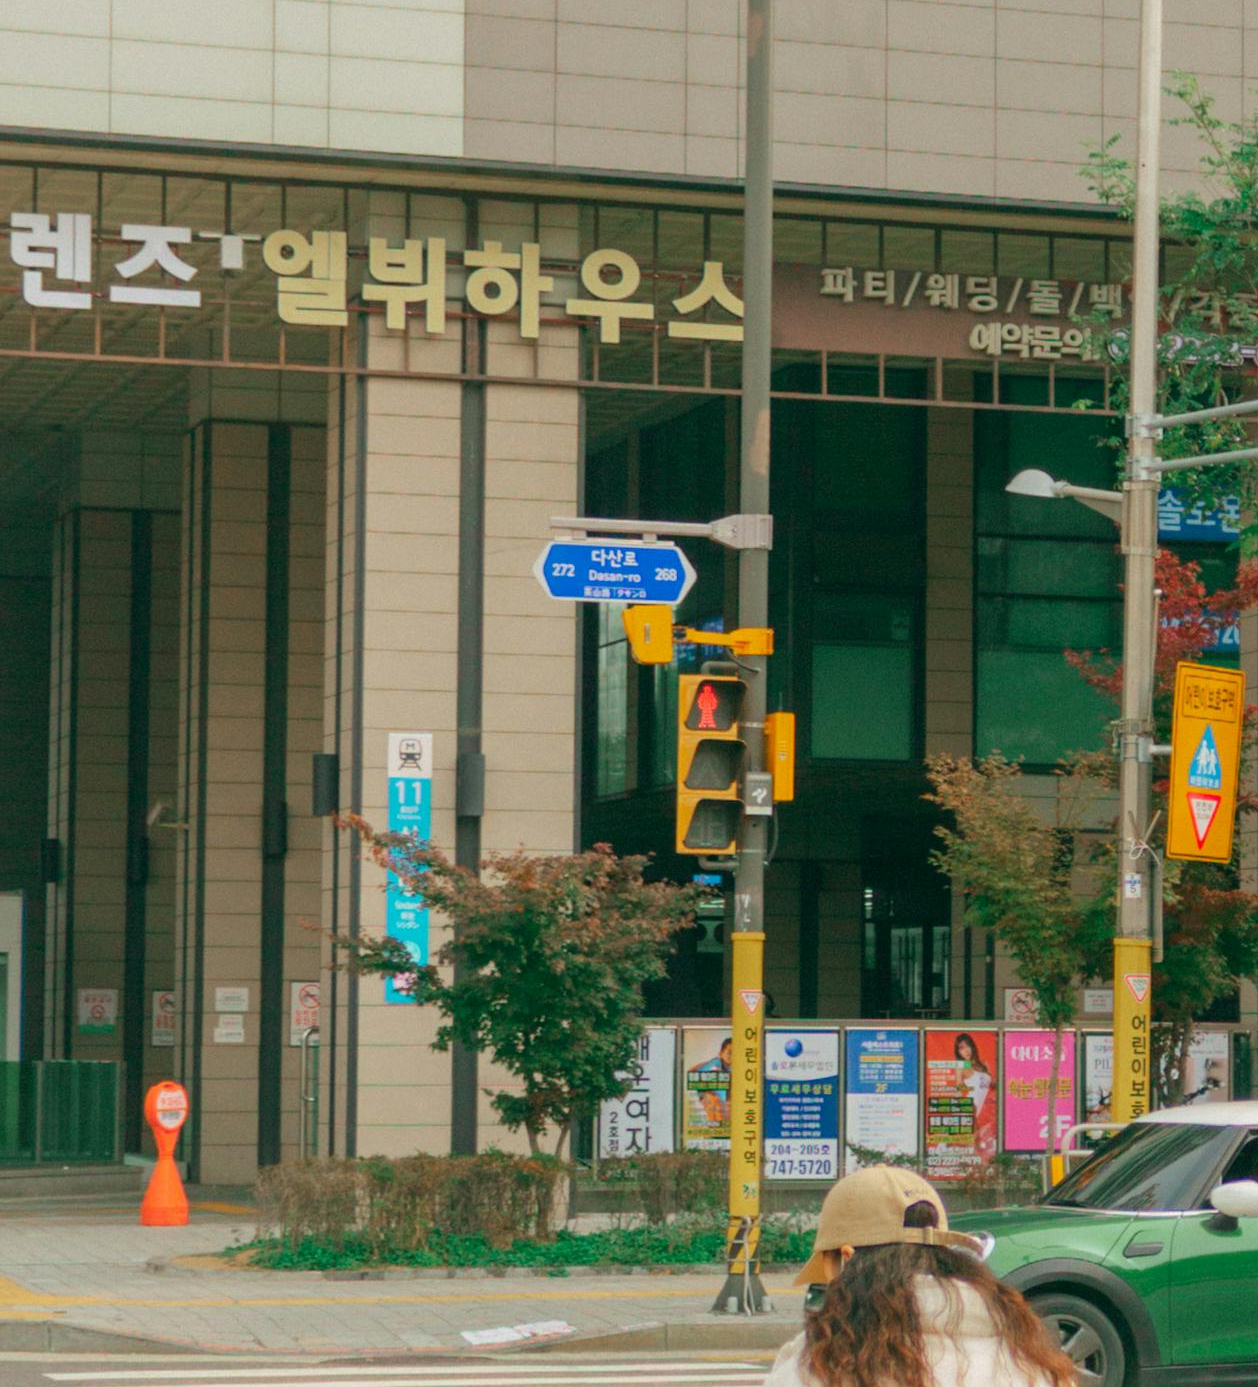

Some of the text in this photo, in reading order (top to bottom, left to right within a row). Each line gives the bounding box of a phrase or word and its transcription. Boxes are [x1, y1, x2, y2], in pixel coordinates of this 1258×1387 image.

[10, 212, 201, 310] 렌즈
[262, 229, 744, 344] 엘뷔하우스
[969, 322, 1099, 362] 예약문의
[591, 549, 639, 568] 다산로
[552, 563, 576, 577] 272
[588, 570, 641, 583] Dasan-ro
[655, 568, 678, 582] 268
[395, 781, 422, 804] 11
[743, 1027, 757, 1165] 어린이보호구역
[1008, 1077, 1072, 1099] 속눈썹문
[1039, 1114, 1072, 1138] 2F
[770, 1160, 832, 1175] 747-5720
